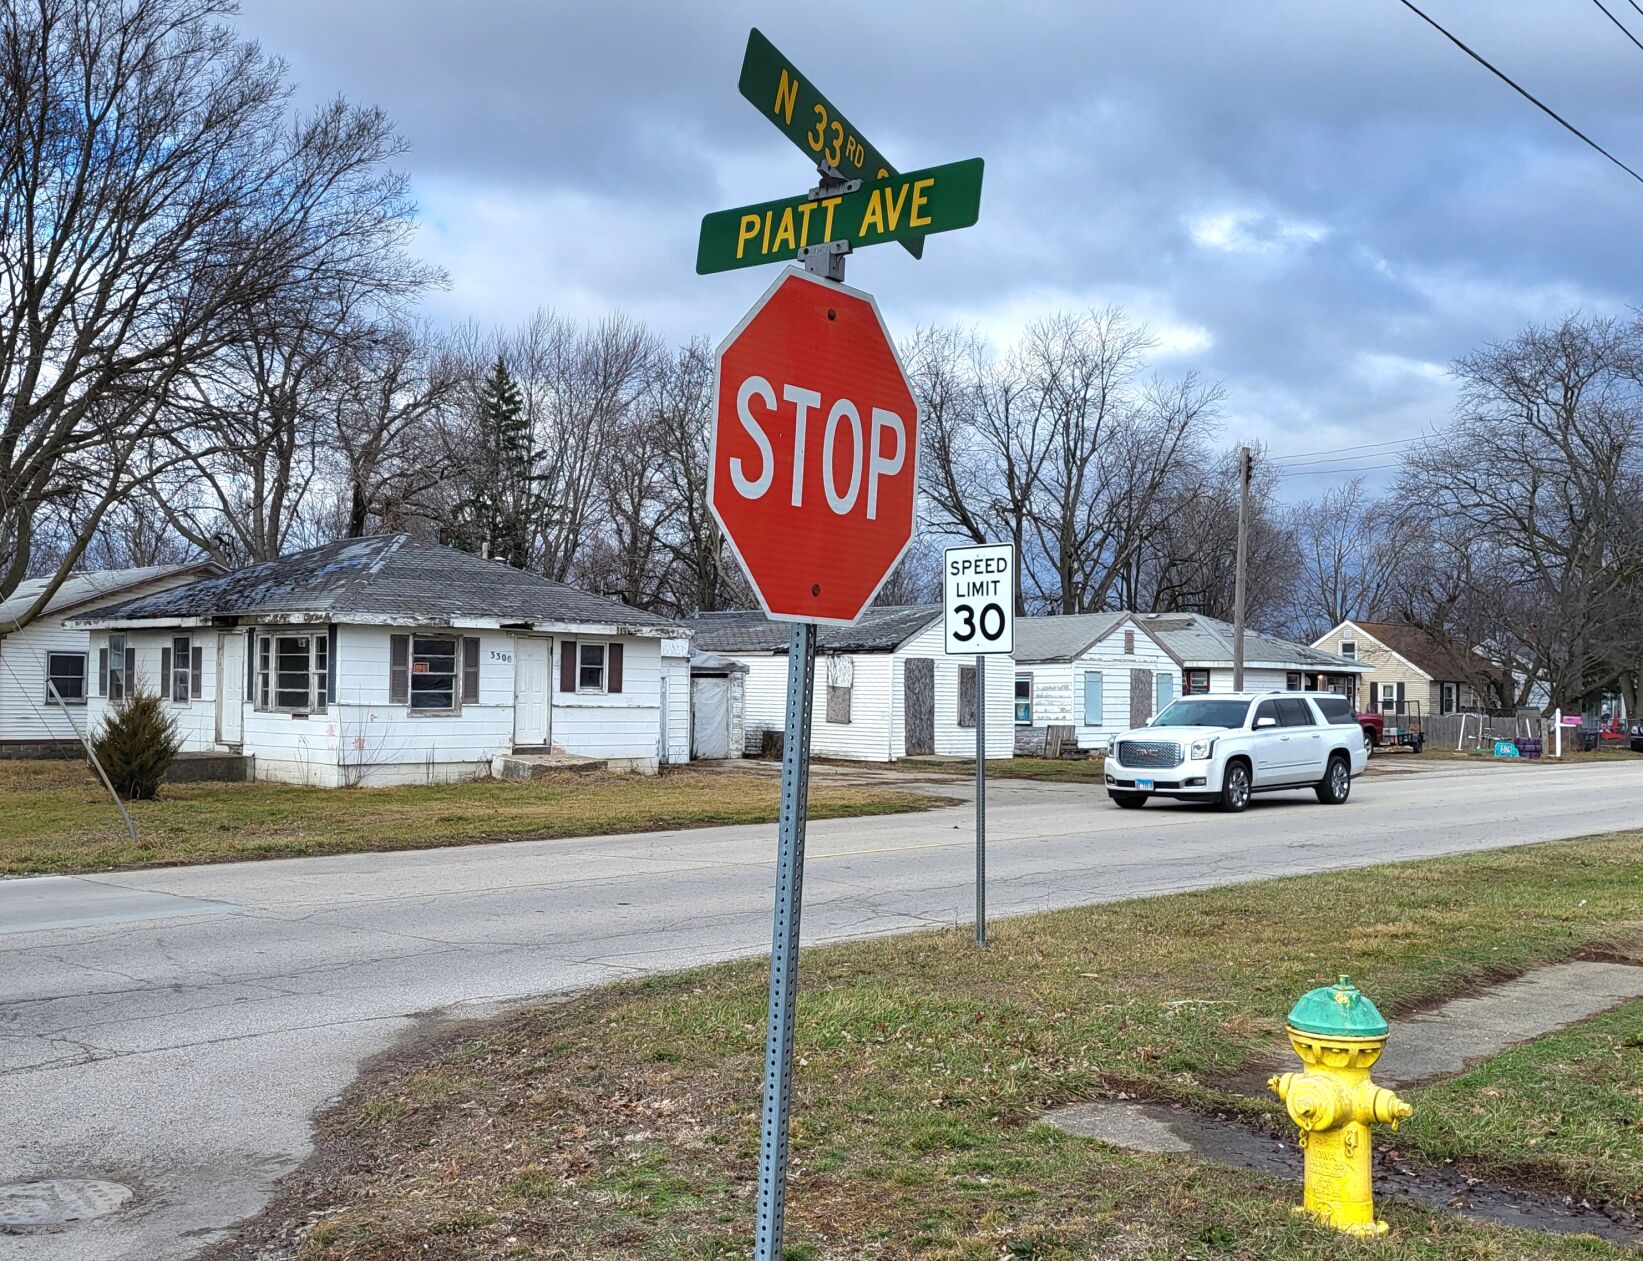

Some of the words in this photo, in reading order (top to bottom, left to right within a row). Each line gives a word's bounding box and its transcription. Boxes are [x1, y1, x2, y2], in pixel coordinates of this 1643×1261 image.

[774, 68, 799, 126] N
[736, 197, 842, 259] PIATT
[859, 178, 935, 238] AVE
[729, 375, 907, 521] STOP
[950, 557, 1008, 576] SPEED
[956, 580, 1001, 598] LIMIT
[952, 602, 1006, 642] 30
[490, 650, 512, 664] 3300
